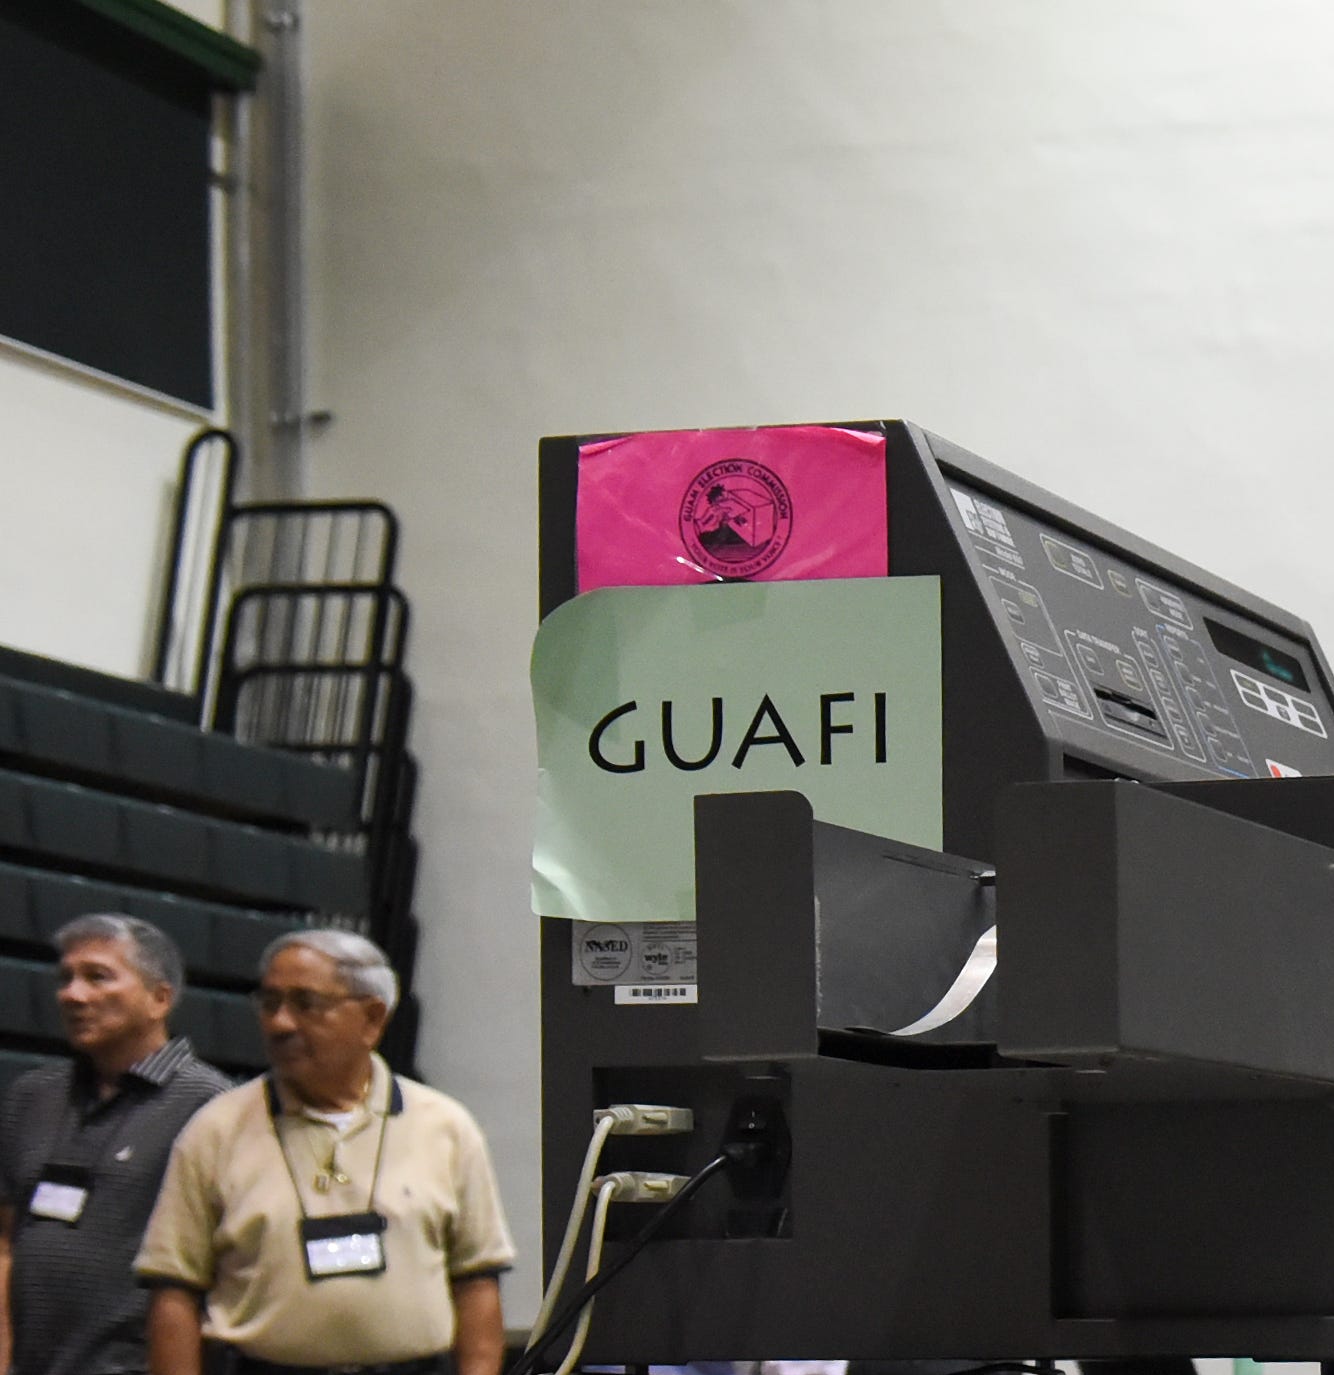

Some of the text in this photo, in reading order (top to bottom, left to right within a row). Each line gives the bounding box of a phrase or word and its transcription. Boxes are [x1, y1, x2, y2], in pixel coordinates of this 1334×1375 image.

[683, 463, 788, 522] GUAM ELECTION COMMISSION
[589, 692, 887, 773] GUAFI
